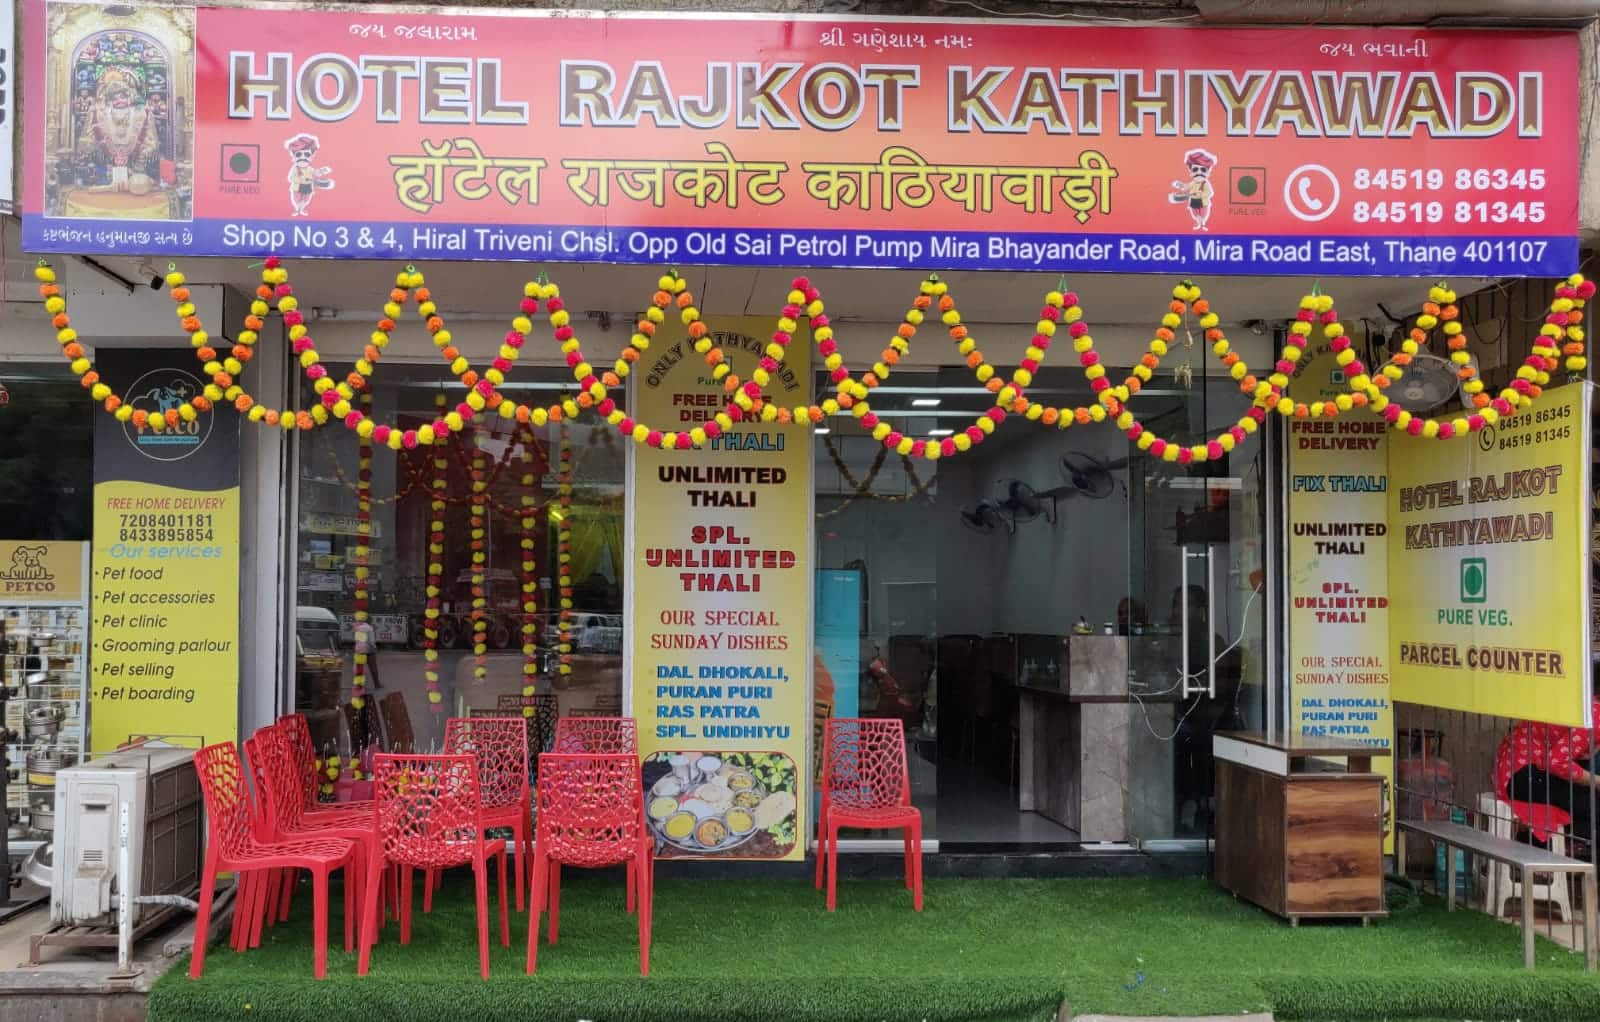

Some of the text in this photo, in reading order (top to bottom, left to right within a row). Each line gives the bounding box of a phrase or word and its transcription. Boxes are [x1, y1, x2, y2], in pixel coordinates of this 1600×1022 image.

[349, 24, 478, 41] જય જલારામ
[819, 27, 846, 47] શ્રી
[853, 28, 928, 53] ગણેશાય
[1319, 38, 1429, 57] જય ભવાની
[227, 50, 1544, 139] HOTEL RAJKOT KATHIYAWADI
[390, 137, 1119, 225] हॉटेल राजकोट काठियावाड़ी
[1353, 168, 1546, 190] 84519 86345
[1353, 200, 1546, 223] 84519 81345
[182, 227, 193, 246] છે
[223, 223, 1548, 265] Shop No 3 & 4, Hiral Triveni Chsl. Opp Old Sai Petrol Pump Mira Bhayander Road, Mira Road East, Thane 401107
[646, 331, 800, 392] ONLY KTHYAADI
[673, 394, 717, 406] FREE
[1499, 404, 1571, 431] 84519 86345
[1292, 421, 1386, 434] FREE HOME
[711, 432, 785, 451] THALI
[1299, 437, 1380, 450] DELIVERY
[1499, 426, 1570, 450] 84519 81345
[658, 465, 786, 484] UNLIMITED
[1293, 475, 1387, 493] FIX THALI
[1400, 464, 1562, 512] HOTEL RAJKOT
[107, 498, 225, 510] FREE HOME DELIVERY
[687, 490, 756, 507] THALI
[120, 514, 212, 527] 7208401181
[120, 528, 214, 541] 8433895854
[691, 526, 750, 544] SPL.
[1294, 523, 1387, 537] UNLIMITED
[1405, 511, 1554, 550] KATHIYAWADI
[109, 543, 222, 559] Our services
[1315, 542, 1365, 555] THALI
[646, 549, 796, 569] UNLIMITED
[102, 567, 164, 580] Pet food
[5, 581, 56, 592] PETCO
[680, 573, 761, 592] THALI
[102, 591, 215, 604] Pet accessories
[1294, 597, 1389, 609] UNLIMITED
[102, 615, 168, 628] Pet clinic
[660, 610, 780, 626] OUR SPECIAL
[1315, 612, 1366, 623] THALI
[1437, 609, 1512, 626] PURE VEG.
[102, 638, 231, 655] Grooming parlour
[651, 632, 788, 650] SUNDAY DISHES
[1301, 656, 1382, 668] OUR SPECIAL
[1400, 643, 1566, 676] PARCEL COUNTER
[101, 663, 175, 678] Pet selling
[656, 665, 789, 682] DAL DHOKALI,
[1296, 670, 1389, 684] SUNDAY DISHES
[101, 686, 195, 703] Pet boarding
[656, 685, 773, 699] PURAN PURI
[1302, 698, 1326, 707] DAL
[656, 705, 760, 719] RAS PATRA
[1302, 712, 1378, 720] PURAN PURI
[703, 725, 790, 739] UNDHIYU
[1330, 725, 1369, 734] PATRA
